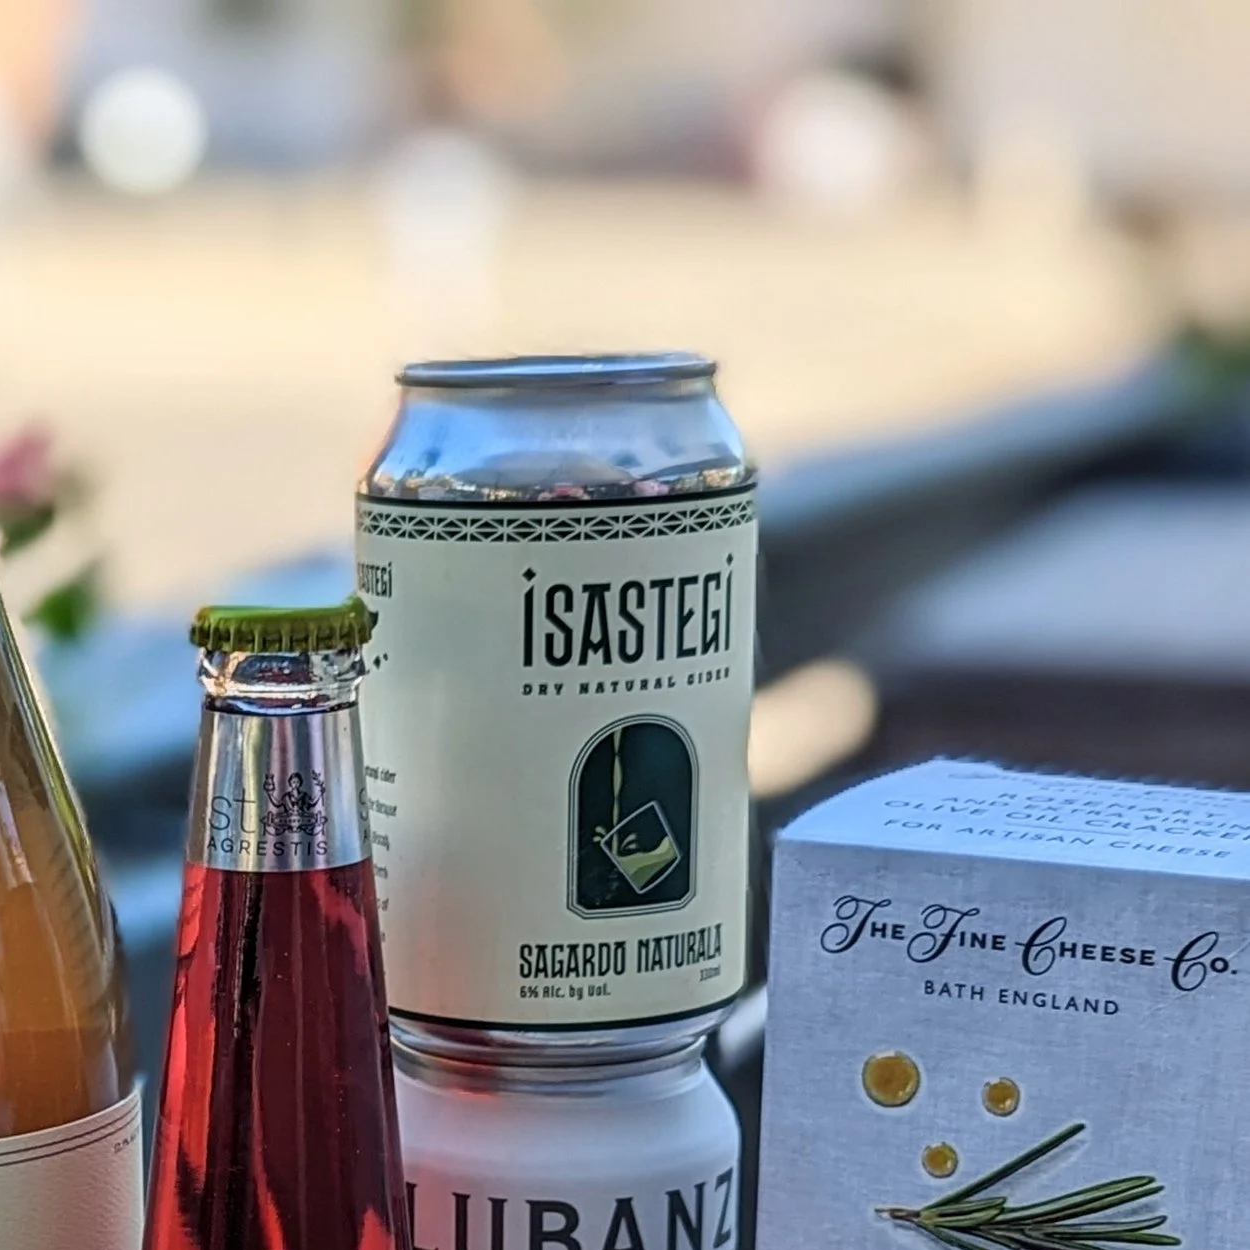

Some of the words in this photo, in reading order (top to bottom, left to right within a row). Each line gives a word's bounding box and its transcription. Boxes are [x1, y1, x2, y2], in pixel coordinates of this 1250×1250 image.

[523, 683, 563, 696] DRY
[579, 675, 676, 695] NATURAL
[207, 836, 329, 856] AGRESTIS
[884, 819, 942, 832] FOR
[955, 827, 1094, 846] ARTISAN
[1109, 840, 1232, 859] CHEESE
[519, 941, 627, 979] SAGARDO
[636, 923, 723, 974] NATURALA
[569, 985, 583, 1001] by
[923, 980, 985, 1002] BATH
[998, 988, 1120, 1016] ENGLAND
